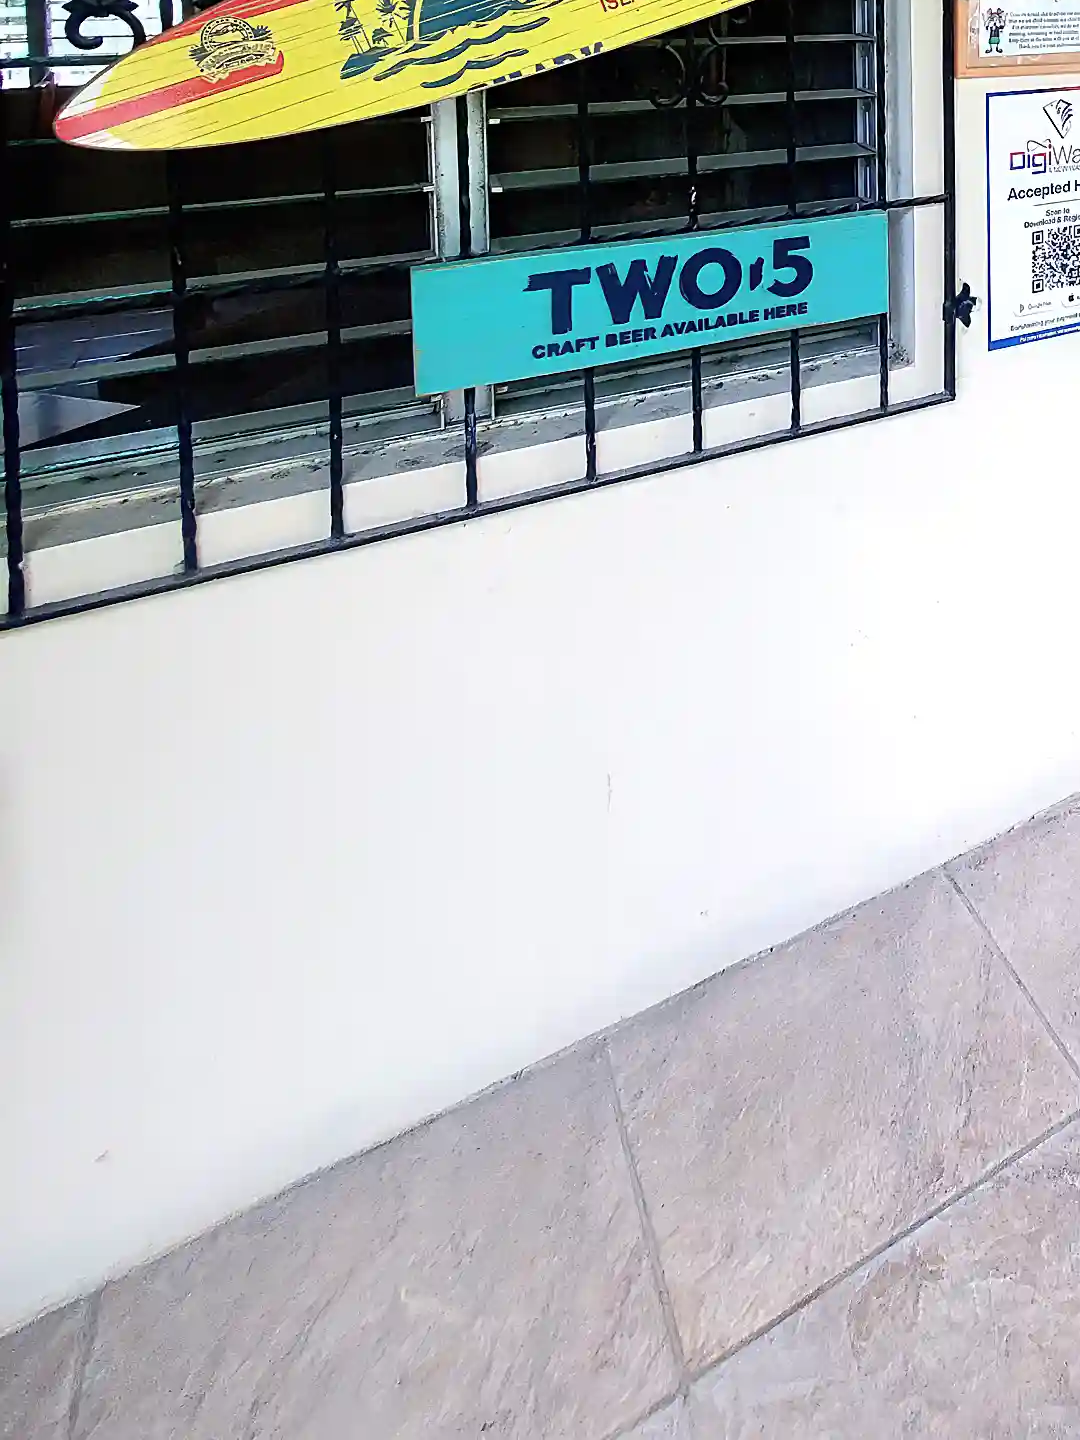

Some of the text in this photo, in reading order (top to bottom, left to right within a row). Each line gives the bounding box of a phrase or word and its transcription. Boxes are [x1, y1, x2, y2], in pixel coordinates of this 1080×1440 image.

[1007, 180, 1070, 201] Accepted
[531, 302, 808, 360] CRAFT BEER AVAILABLE HERE
